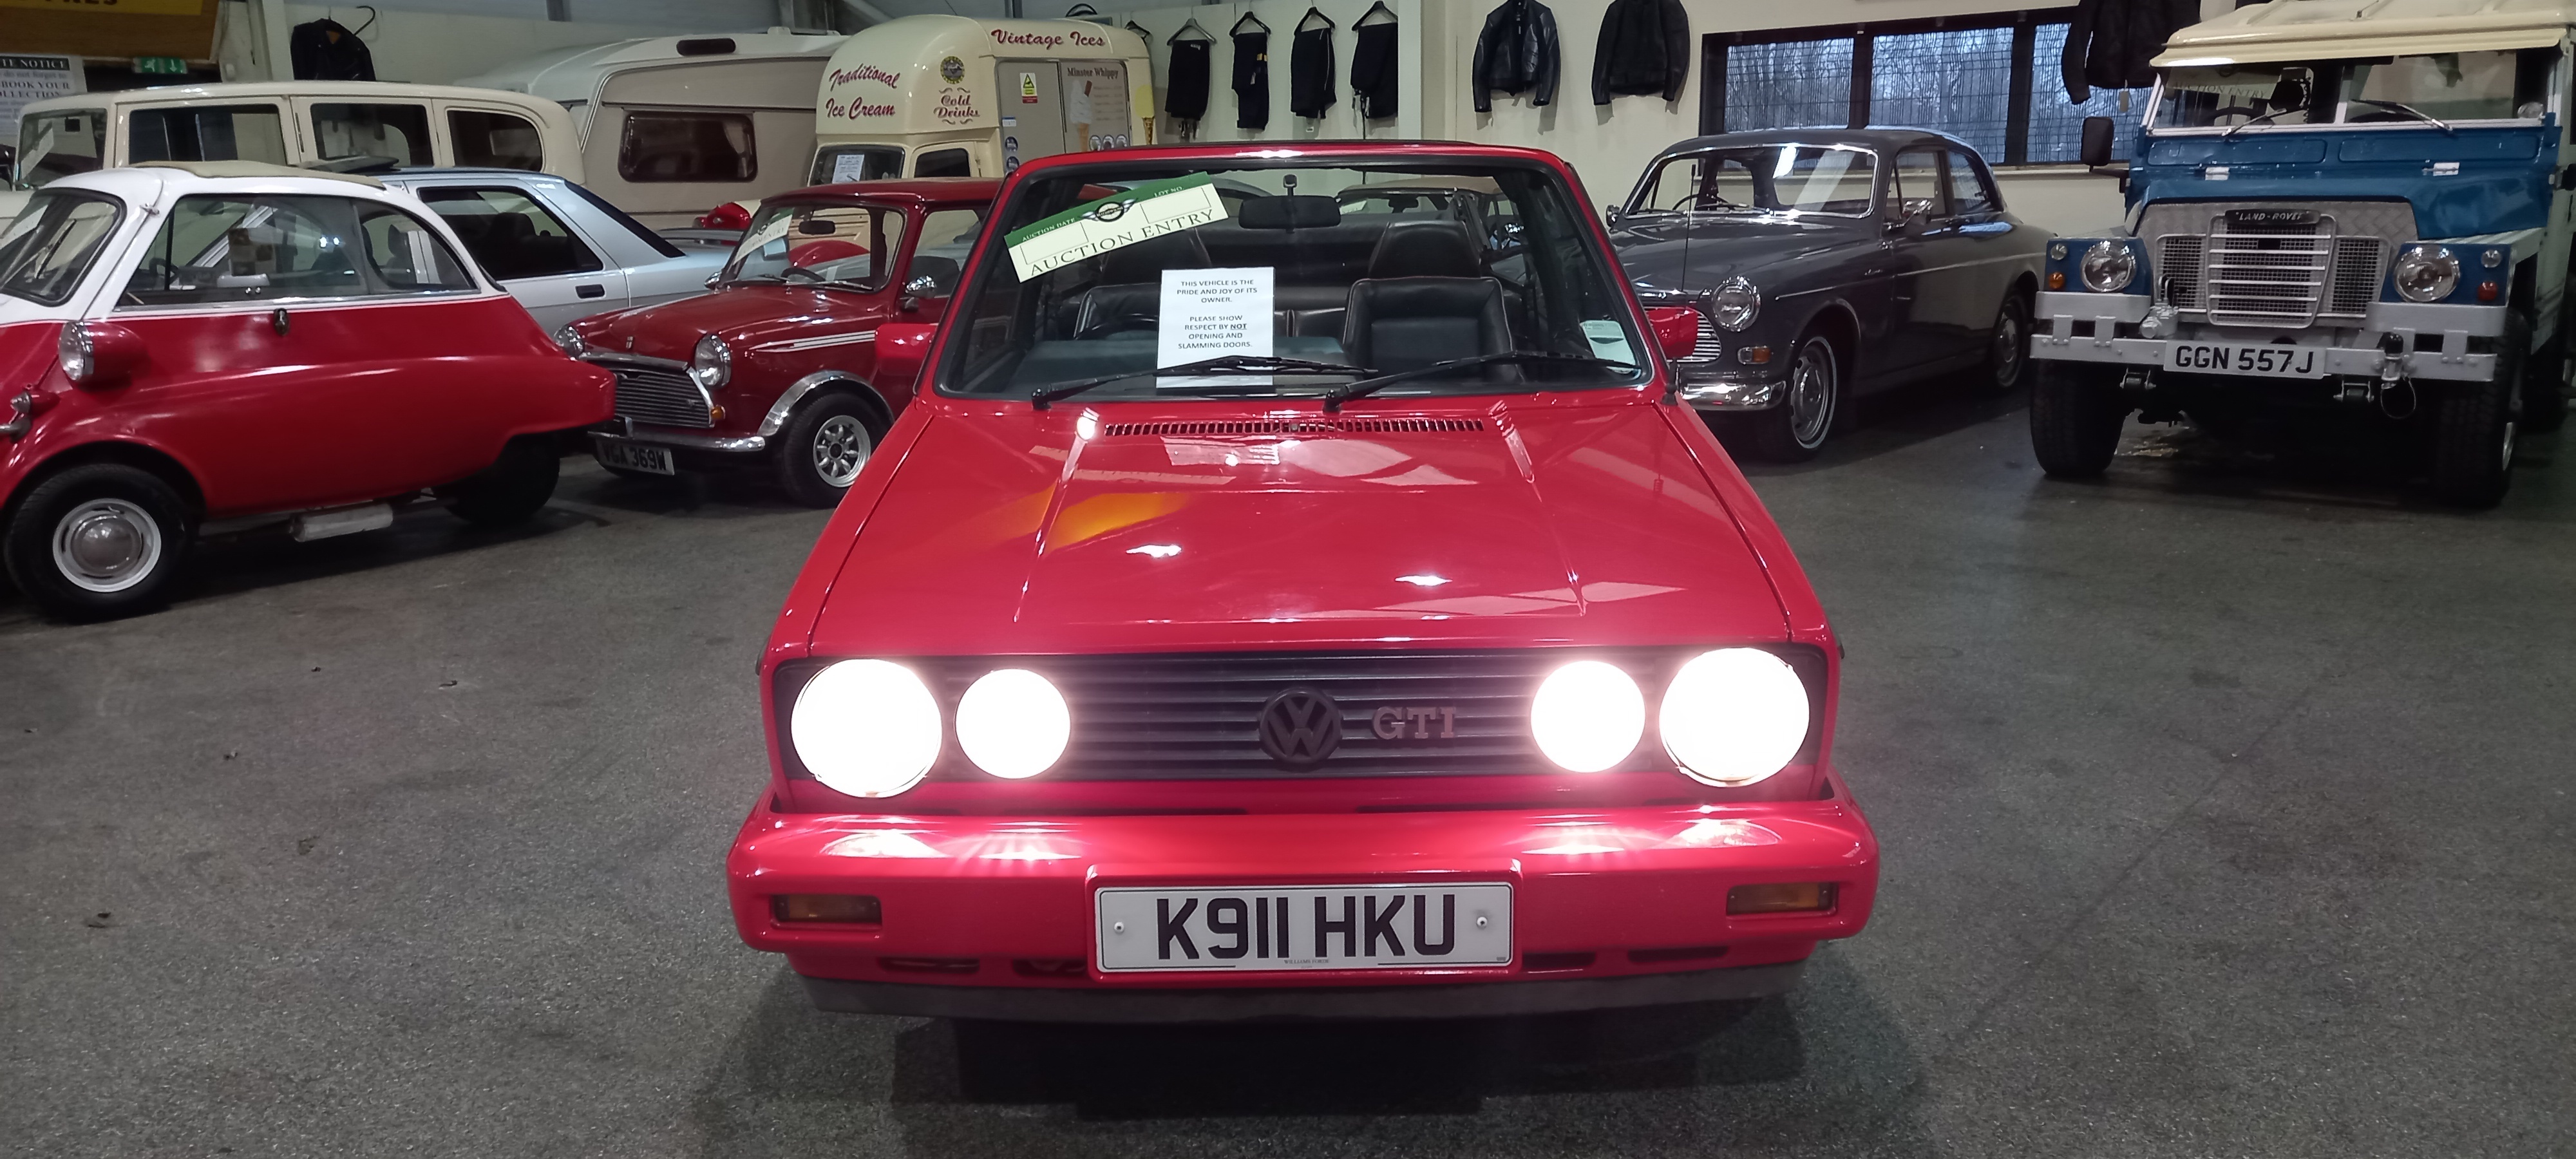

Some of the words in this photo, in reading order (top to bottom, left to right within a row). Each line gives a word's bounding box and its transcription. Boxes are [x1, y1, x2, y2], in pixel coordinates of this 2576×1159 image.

[990, 29, 1064, 50] Vintage
[1070, 31, 1105, 46] Ices
[20, 59, 64, 68] NOTICE
[1067, 68, 1093, 77] Minster
[1094, 68, 1119, 80] Whippy
[37, 81, 70, 90] YOUR
[829, 63, 900, 91] Traditional
[826, 98, 845, 118] Ice
[848, 97, 895, 120] Cream
[933, 106, 980, 118] Drinks
[941, 95, 971, 106] Cold
[1154, 189, 1170, 198] LOT
[1022, 224, 1055, 242] AUCTION
[1056, 218, 1076, 230] DATE
[1030, 231, 1134, 276] AUCTION
[1141, 209, 1213, 239] ENTRY
[2175, 345, 2230, 370] GGN
[2237, 348, 2314, 373] 557J
[629, 446, 667, 471] 369W
[1264, 692, 1338, 762] VW
[1372, 706, 1456, 740] GTI
[1156, 896, 1289, 960] K911
[1314, 894, 1455, 957] HKU
